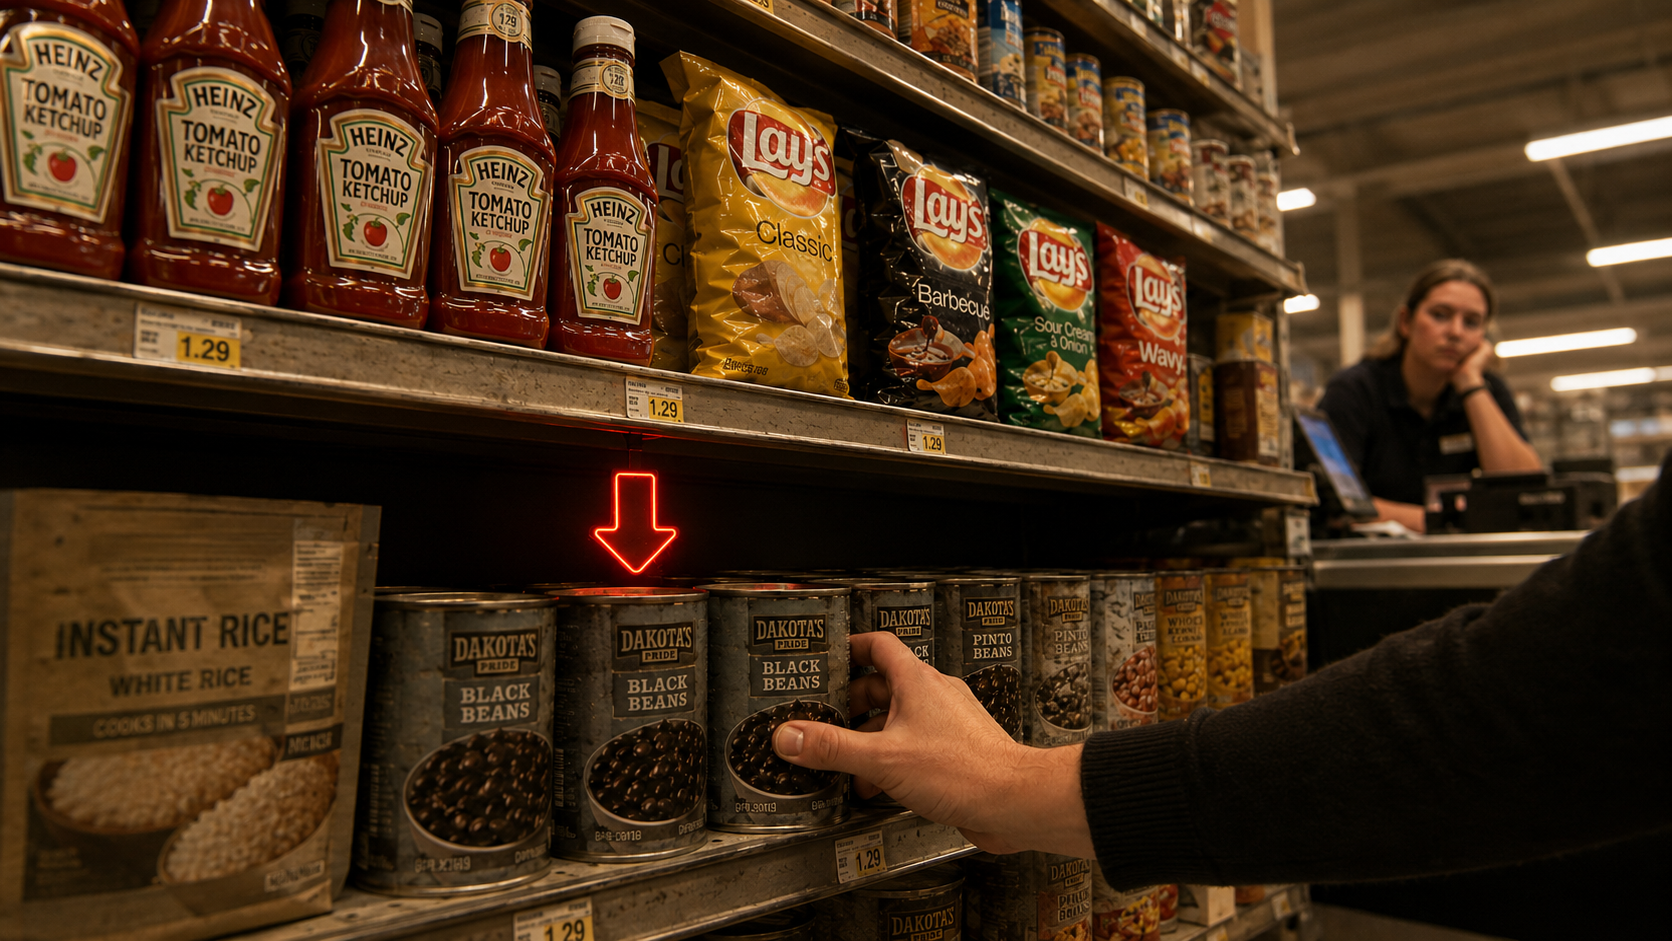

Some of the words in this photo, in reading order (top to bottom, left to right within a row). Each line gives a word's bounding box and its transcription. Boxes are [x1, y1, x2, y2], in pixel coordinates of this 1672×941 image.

[34, 44, 103, 81] HEINZ
[22, 79, 107, 120] TOMATO
[193, 86, 258, 119] HEINZ
[25, 104, 103, 139] KETCHUP
[182, 119, 261, 155] TOMATO
[350, 127, 409, 156] HEINZ
[184, 144, 257, 174] KETCHUP
[340, 159, 411, 191] TOMATO
[476, 161, 529, 188] HEINZ
[343, 181, 408, 208] KETCHUP
[468, 192, 532, 219] TOMATO
[471, 211, 530, 234] KETCHUP
[590, 200, 636, 225] HEINZ
[583, 227, 638, 252] TOMATO
[756, 220, 833, 262] Classic
[586, 246, 636, 267] KETCHUP
[918, 283, 991, 321] Barbecue
[1034, 315, 1063, 335] Sour
[1064, 321, 1094, 342] Cream
[180, 336, 230, 362] 1.29
[1060, 335, 1088, 355] Onion
[1138, 340, 1183, 376] Wavy
[649, 398, 678, 418] 1.29
[922, 435, 942, 451] 1.29
[879, 608, 930, 628] DAKOTA'S
[967, 600, 1015, 618] DAKOTA'S
[55, 614, 209, 660] INSTANT
[218, 611, 290, 648] RICE
[619, 626, 693, 652] DAKOTA'S
[755, 619, 824, 641] DAKOTA'S
[973, 633, 1012, 646] PINTO
[454, 633, 537, 662] DAKOTA'S
[645, 650, 677, 661] PRIDE
[777, 640, 808, 649] PRIDE
[973, 646, 1012, 659] BEANS
[480, 660, 518, 672] PRIDE
[762, 660, 820, 675] BLACK
[108, 670, 193, 697] WHITE
[199, 666, 253, 690] RICE
[461, 682, 531, 704] BLACK
[627, 674, 688, 694] BLACK
[762, 675, 820, 691] BEANS
[461, 702, 531, 724] BEANS
[628, 692, 688, 712] BEANS
[856, 848, 881, 872] 1.29
[891, 906, 955, 936] DAKOTA'S
